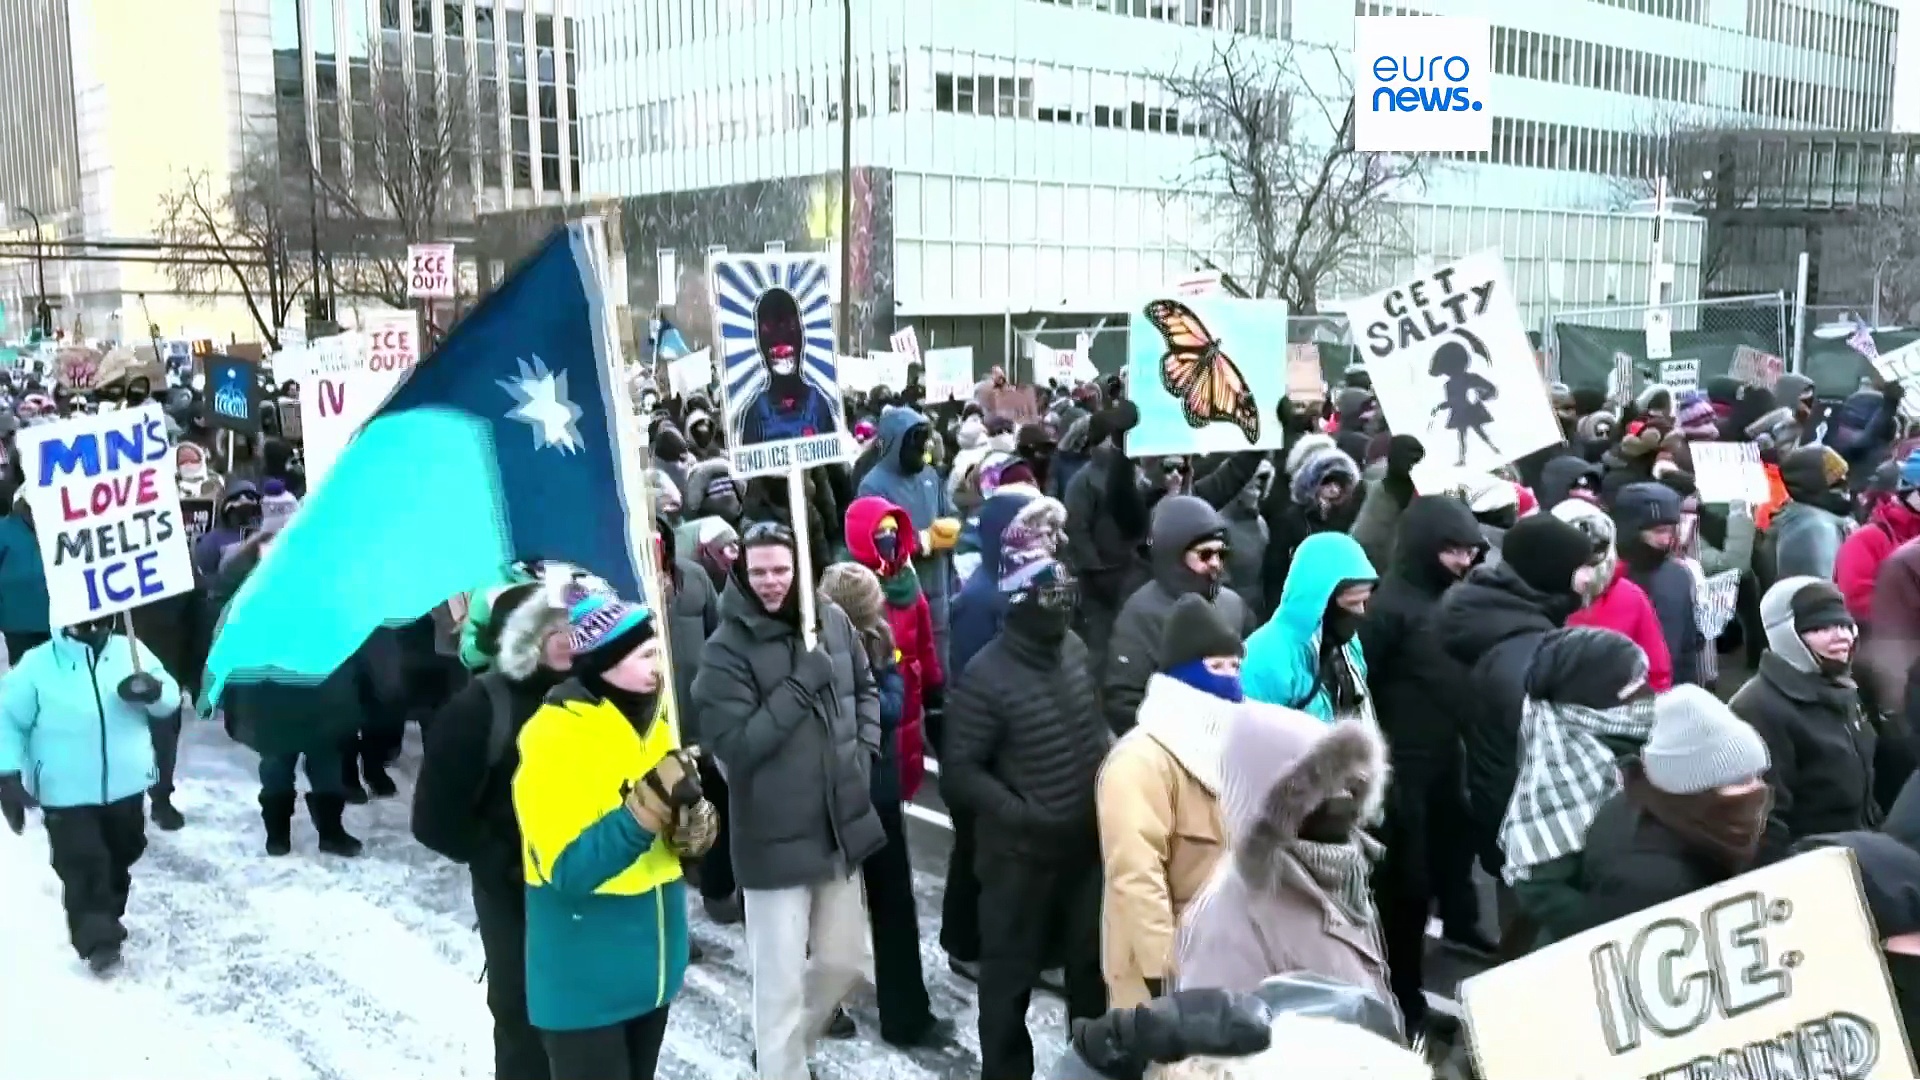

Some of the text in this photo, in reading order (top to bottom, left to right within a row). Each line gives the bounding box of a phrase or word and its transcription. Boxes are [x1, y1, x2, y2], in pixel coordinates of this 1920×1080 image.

[412, 256, 446, 274] ICE
[412, 275, 448, 290] OUT!
[1383, 267, 1455, 318] GET
[370, 331, 411, 351] ICE
[1366, 279, 1496, 358] SALTY
[38, 411, 168, 487] MN'S
[60, 467, 160, 522] LOVE
[53, 509, 174, 566] MELTS
[82, 550, 165, 612] ICE
[1589, 890, 1806, 1057] ICE:
[1641, 1011, 1881, 1080] INED
